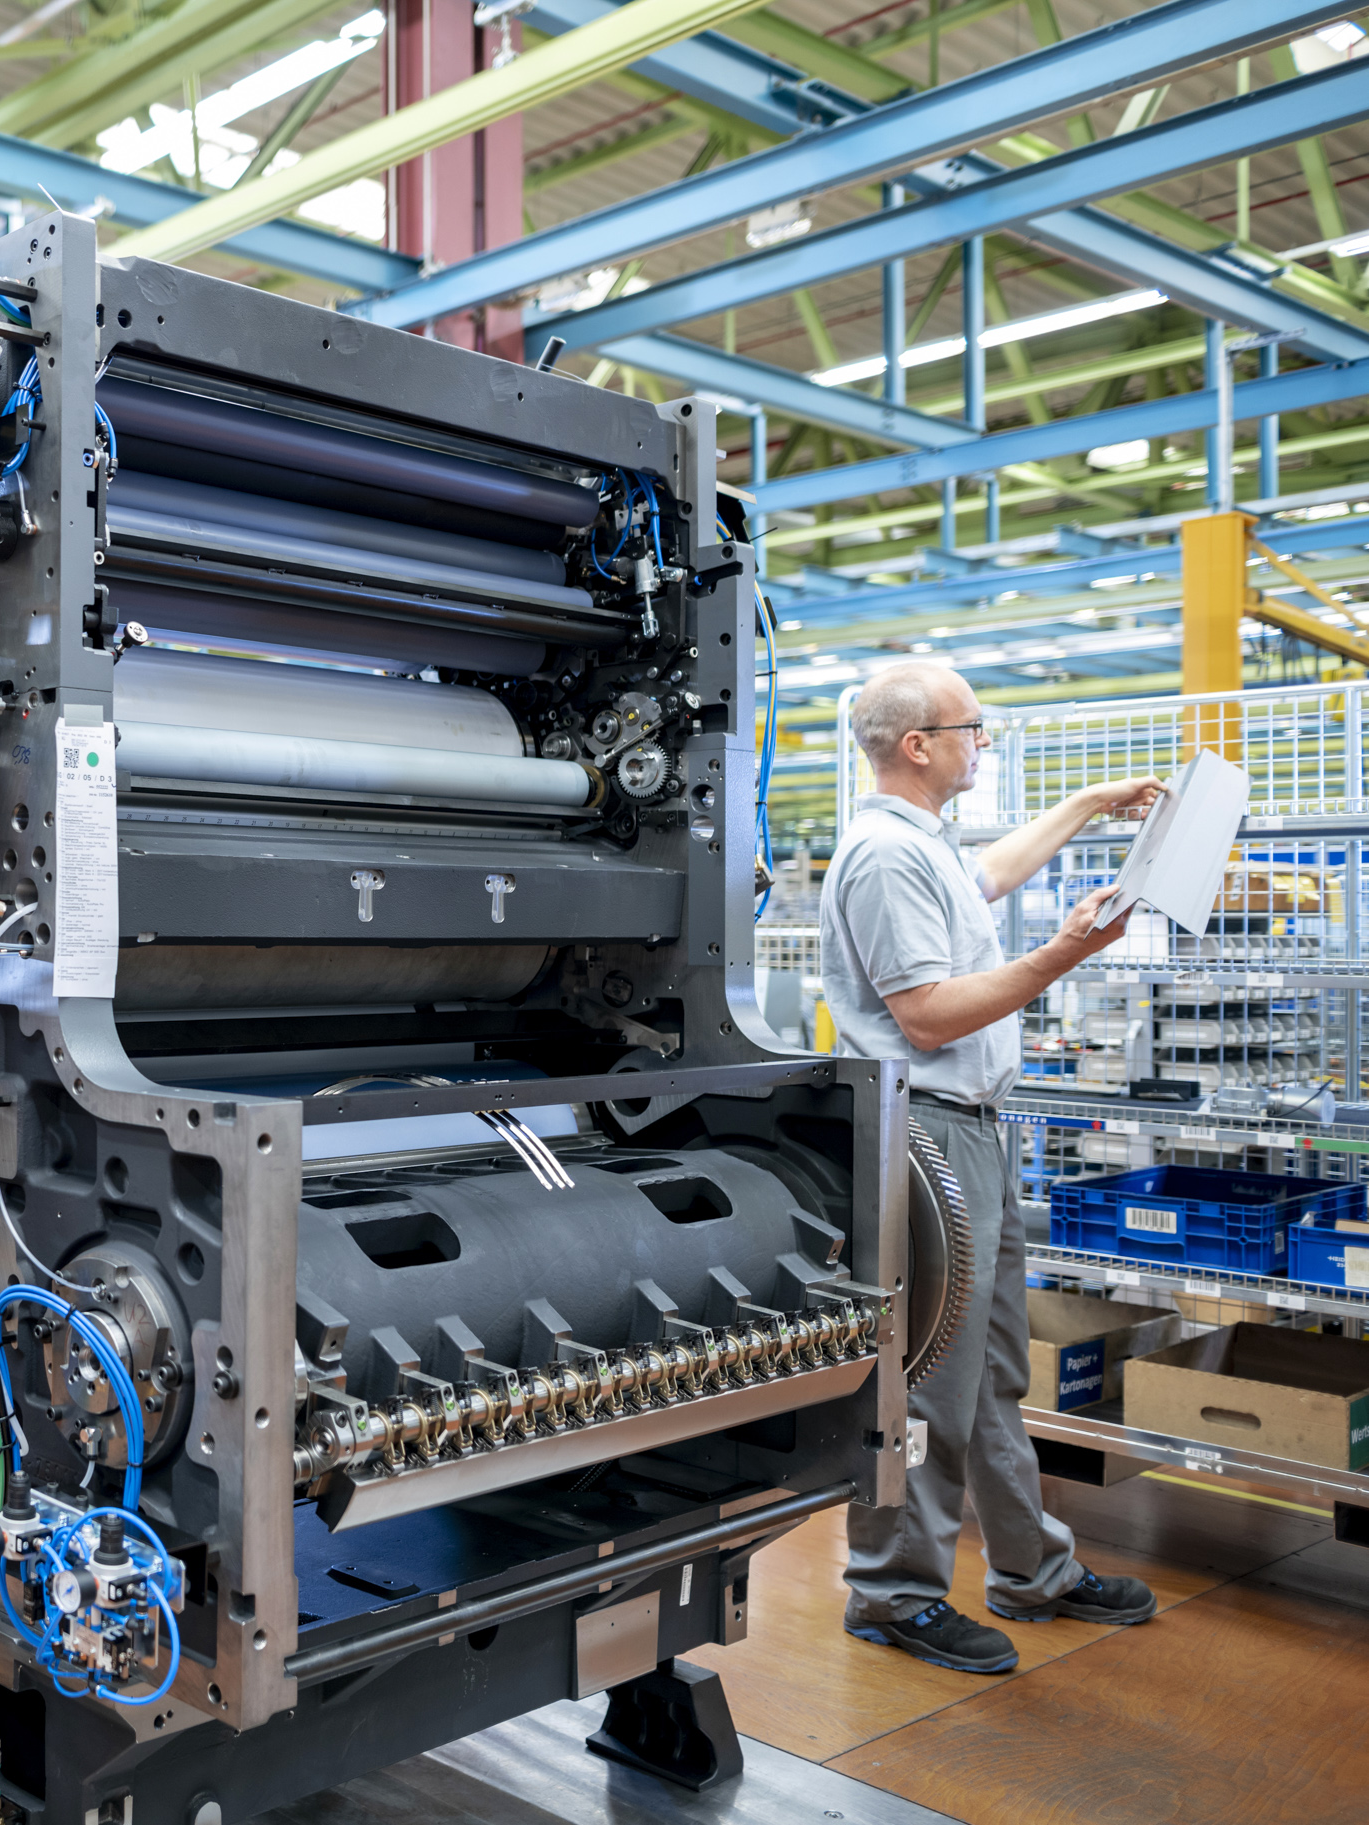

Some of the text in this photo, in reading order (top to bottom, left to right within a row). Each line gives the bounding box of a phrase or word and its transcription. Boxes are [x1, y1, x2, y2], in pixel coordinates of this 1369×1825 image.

[1000, 1114, 1047, 1124] onagen
[1066, 1354, 1092, 1372] Papier
[1060, 1374, 1103, 1395] Kartonagen
